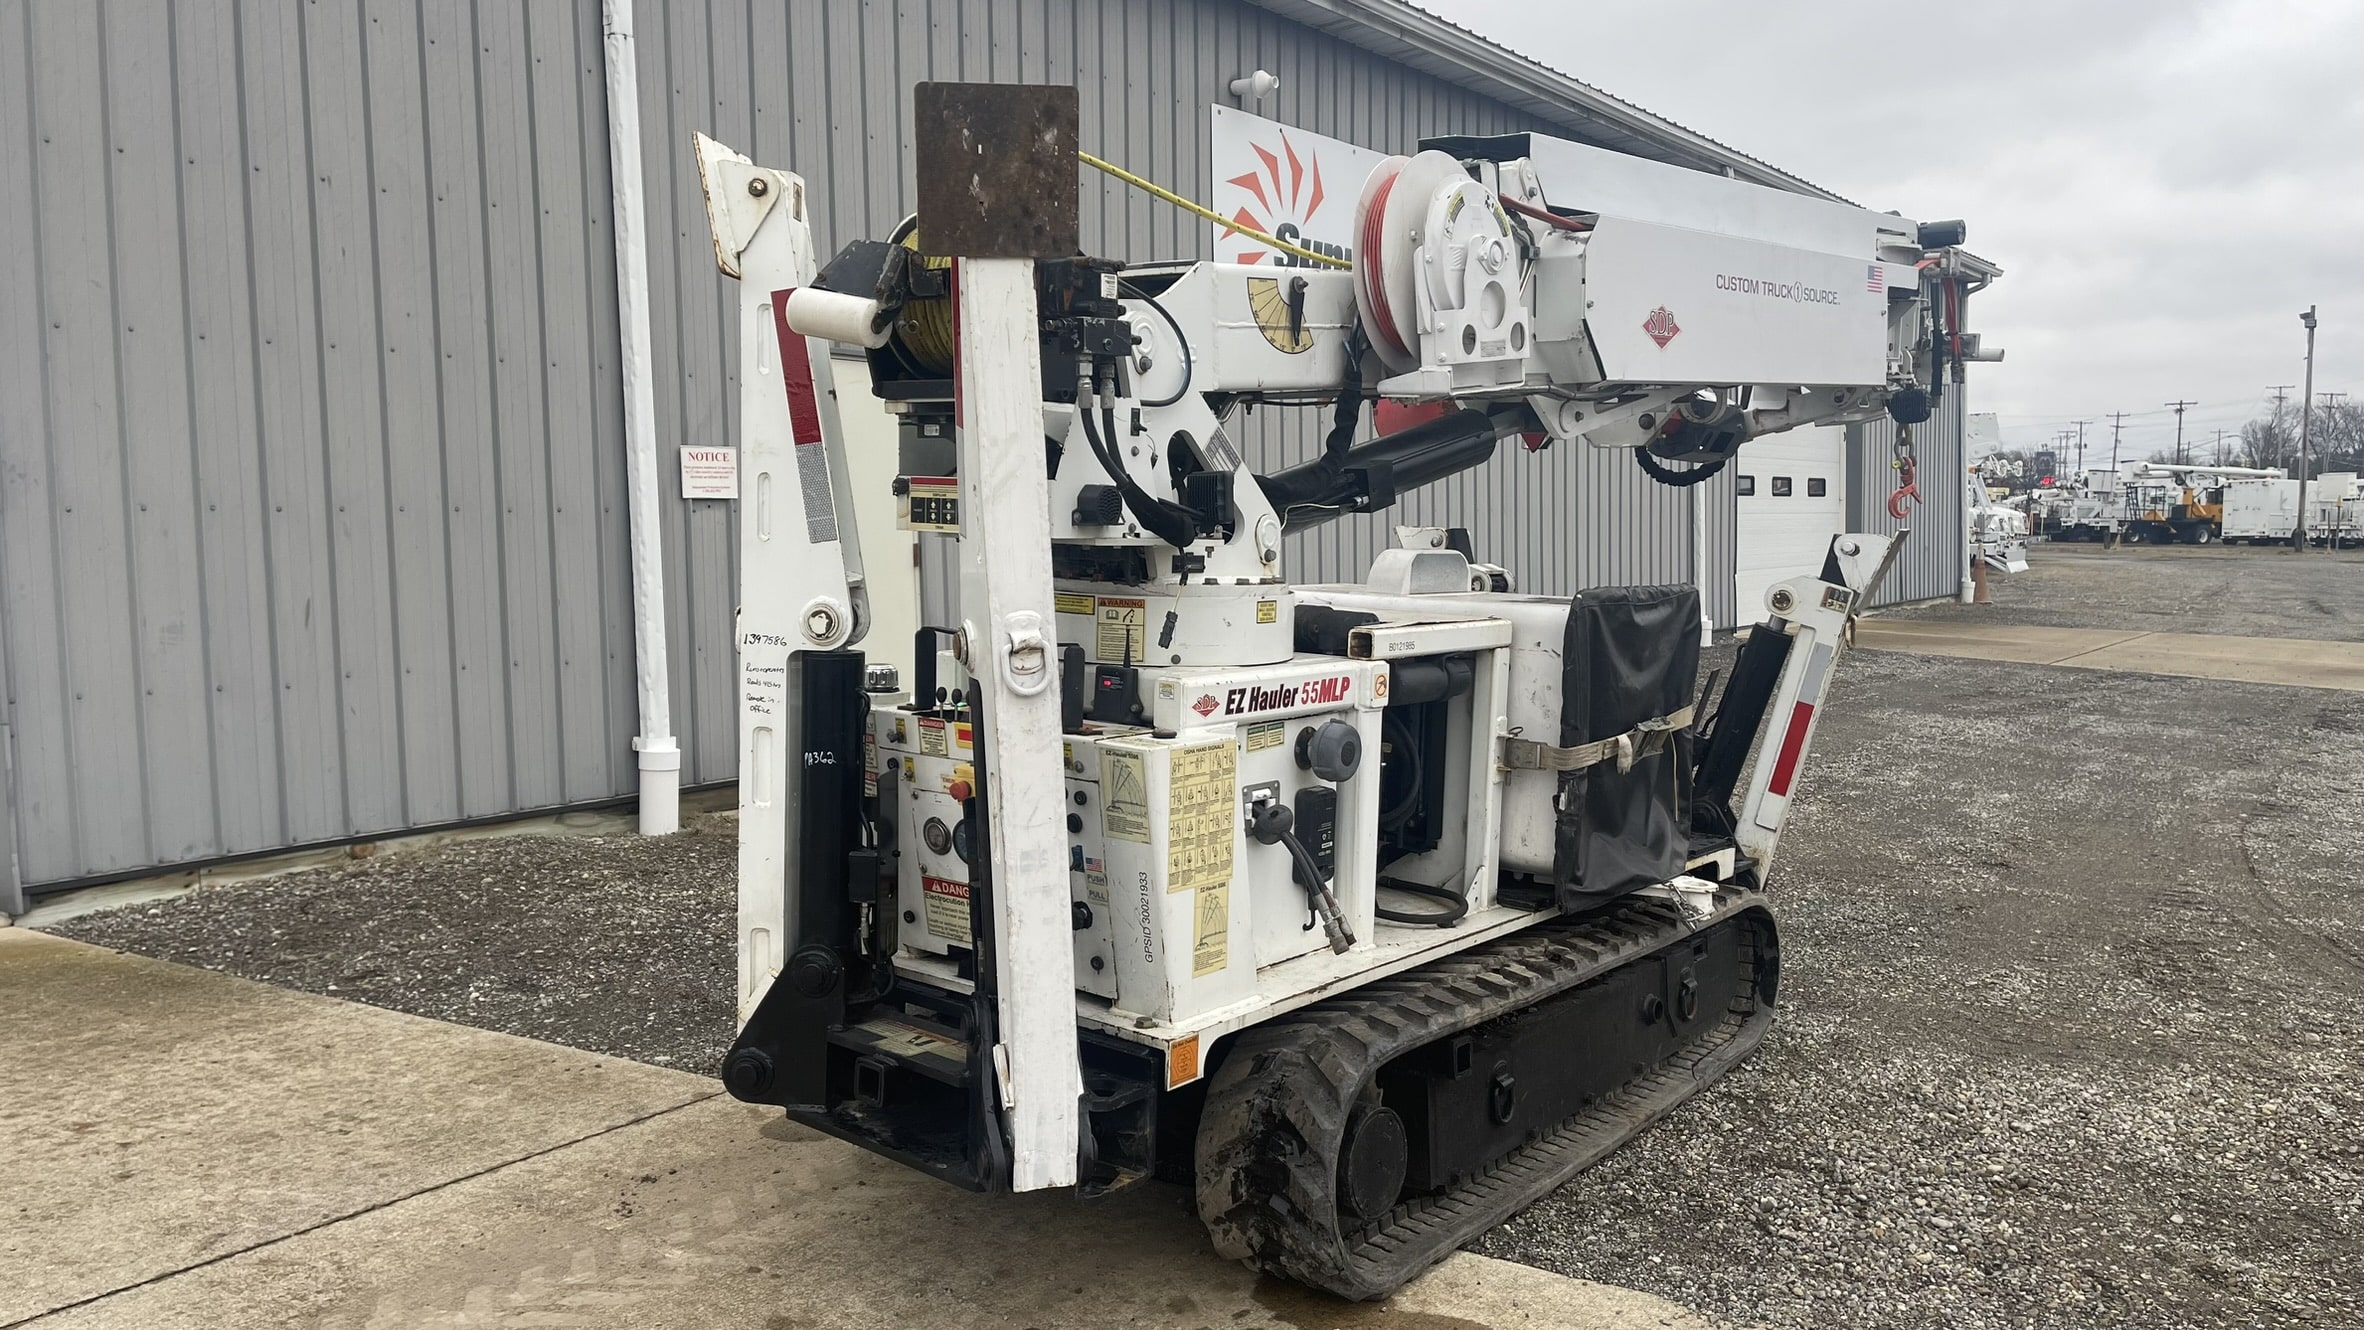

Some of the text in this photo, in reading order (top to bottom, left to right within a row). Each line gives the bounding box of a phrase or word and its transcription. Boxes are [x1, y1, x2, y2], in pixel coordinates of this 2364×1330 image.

[1716, 274, 1759, 294] CUSTOM
[1762, 281, 1793, 299] TRUCK
[688, 451, 730, 462] NOTICE
[1106, 599, 1143, 607] WARNING
[1225, 676, 1350, 715] EZ Hauler 55MLP
[1087, 873, 1105, 883] PUSH
[942, 882, 969, 897] DANG
[1088, 889, 1106, 900] PULL
[1138, 871, 1154, 963] GPSID 30021933
